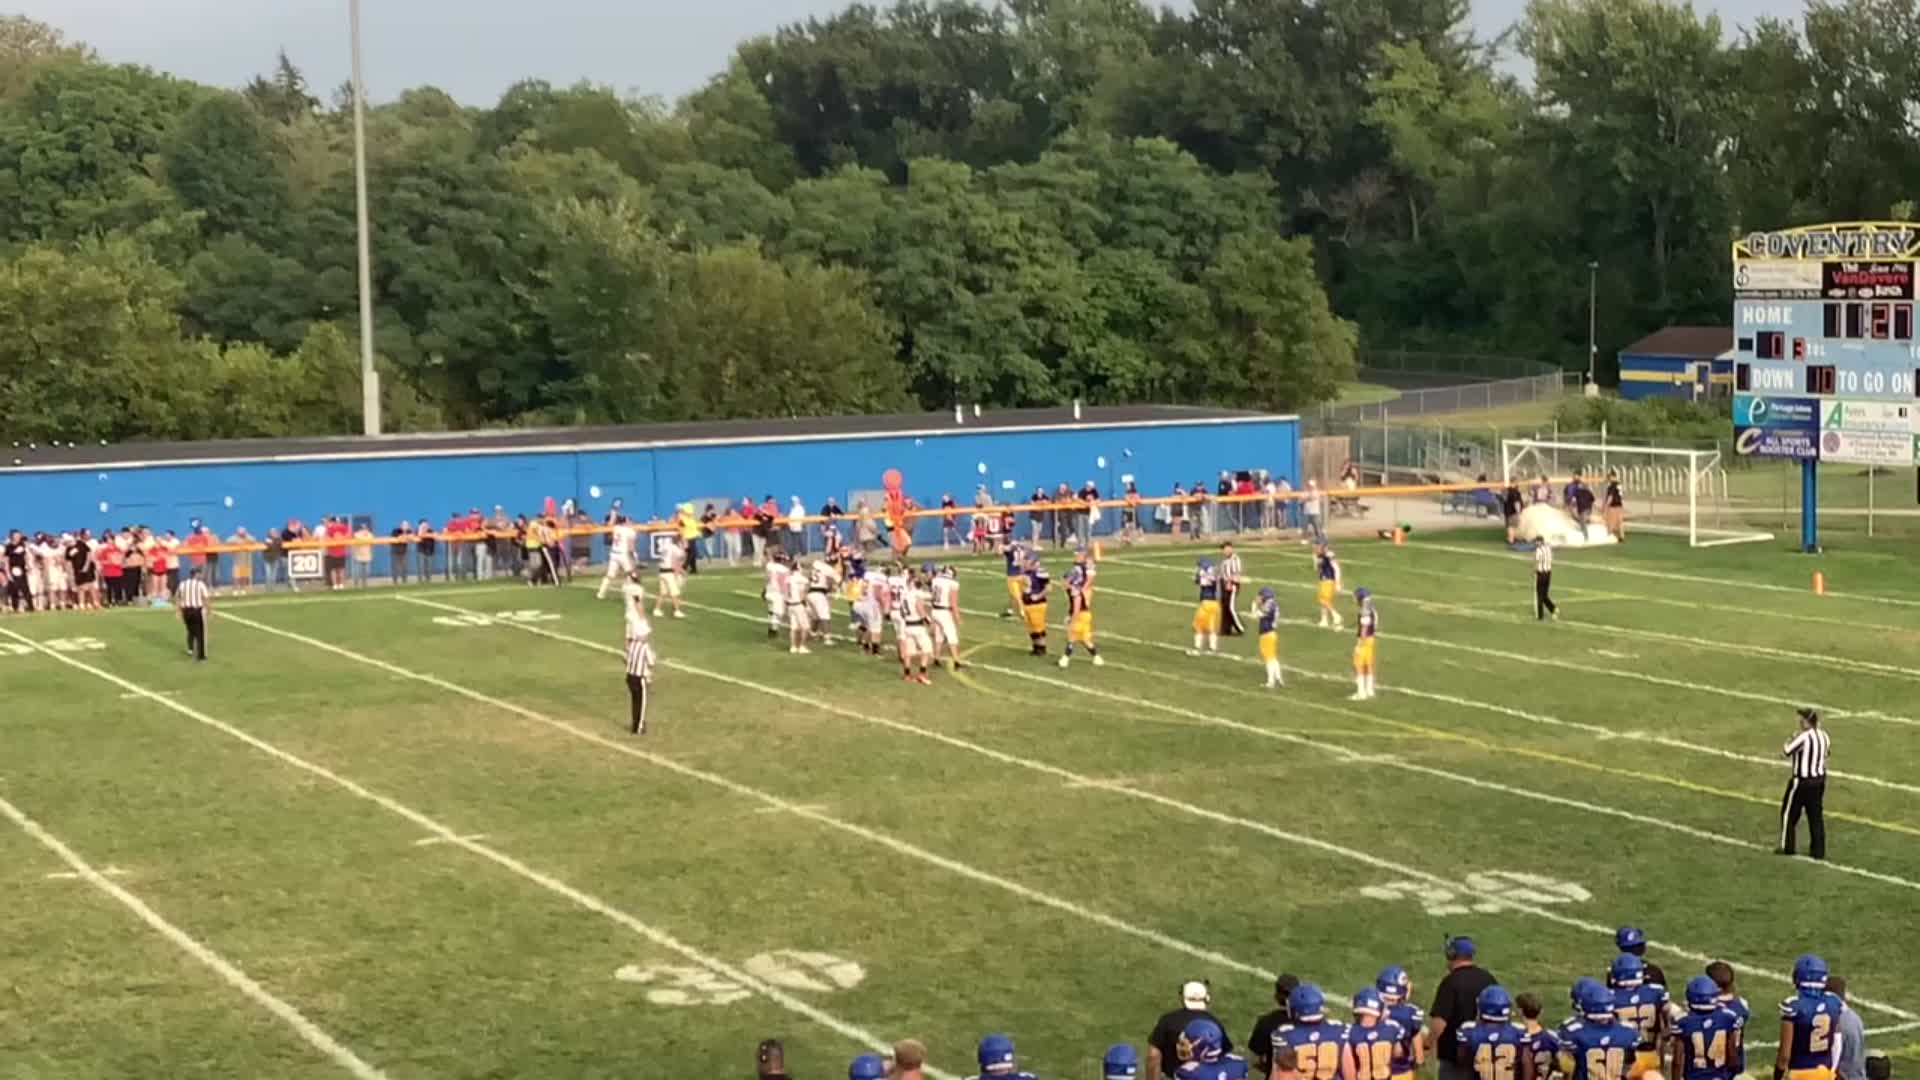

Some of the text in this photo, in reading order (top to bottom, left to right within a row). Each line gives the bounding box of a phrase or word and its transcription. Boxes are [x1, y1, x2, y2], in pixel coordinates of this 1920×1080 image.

[1748, 231, 1915, 256] COVENTRY
[1743, 305, 1793, 325] HOME
[1752, 367, 1794, 389] DOWN
[1838, 370, 1913, 393] TO GO ON
[293, 554, 318, 572] 20
[1809, 1013, 1831, 1053] 2
[1472, 1042, 1516, 1080] 42
[1692, 1029, 1727, 1069] 14
